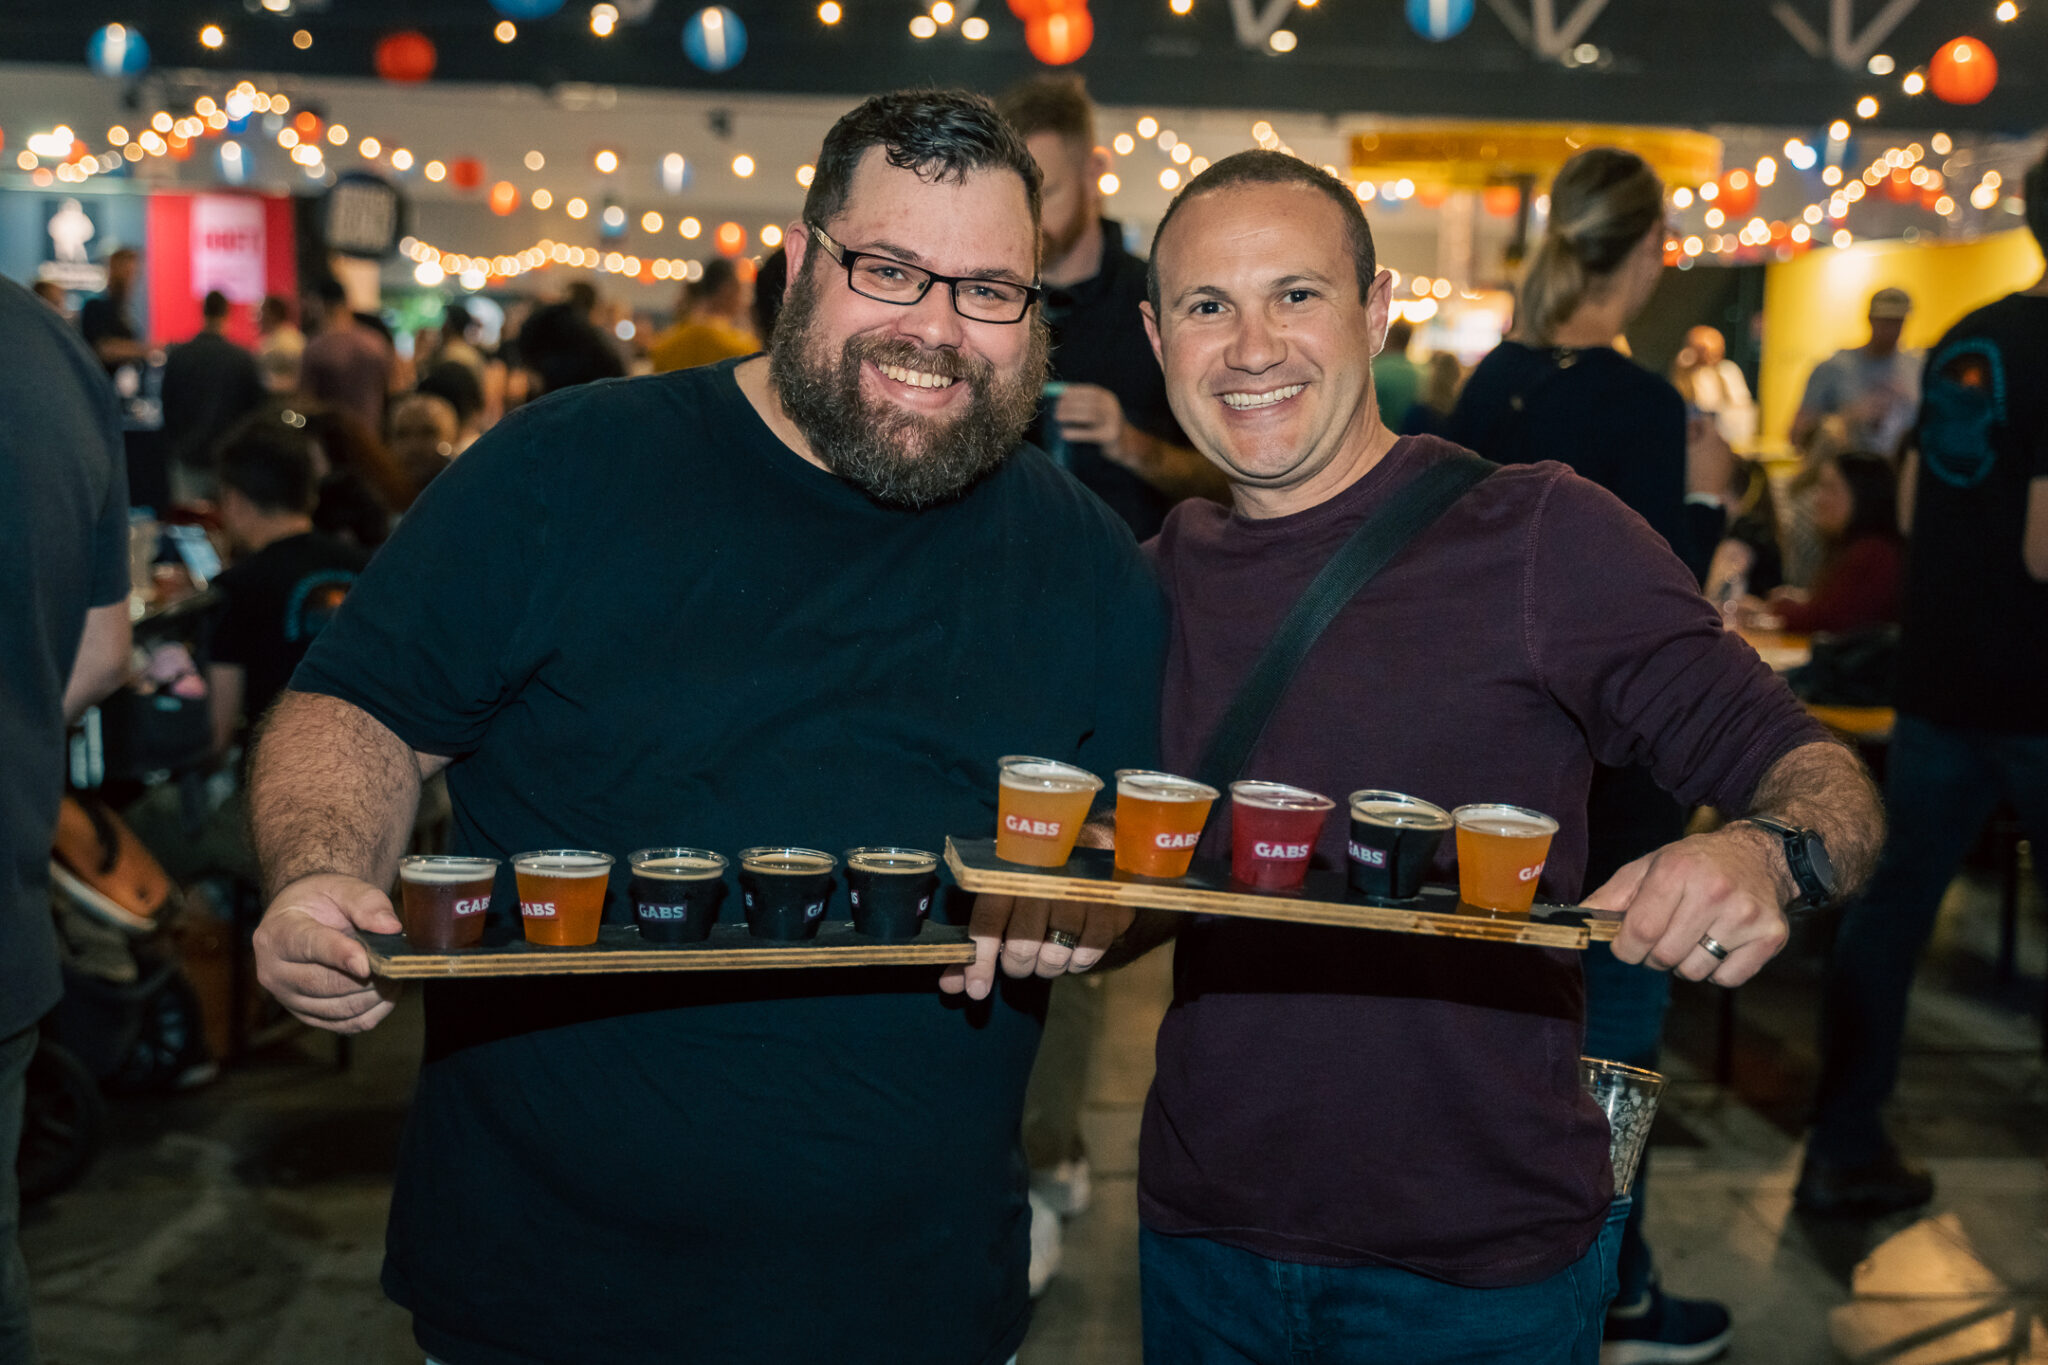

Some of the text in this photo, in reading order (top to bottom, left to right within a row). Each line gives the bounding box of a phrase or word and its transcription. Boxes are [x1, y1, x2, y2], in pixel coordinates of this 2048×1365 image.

[1006, 815, 1060, 836] GABS
[1254, 842, 1309, 858] GABS
[456, 896, 491, 915] GAB
[639, 904, 684, 919] GABS
